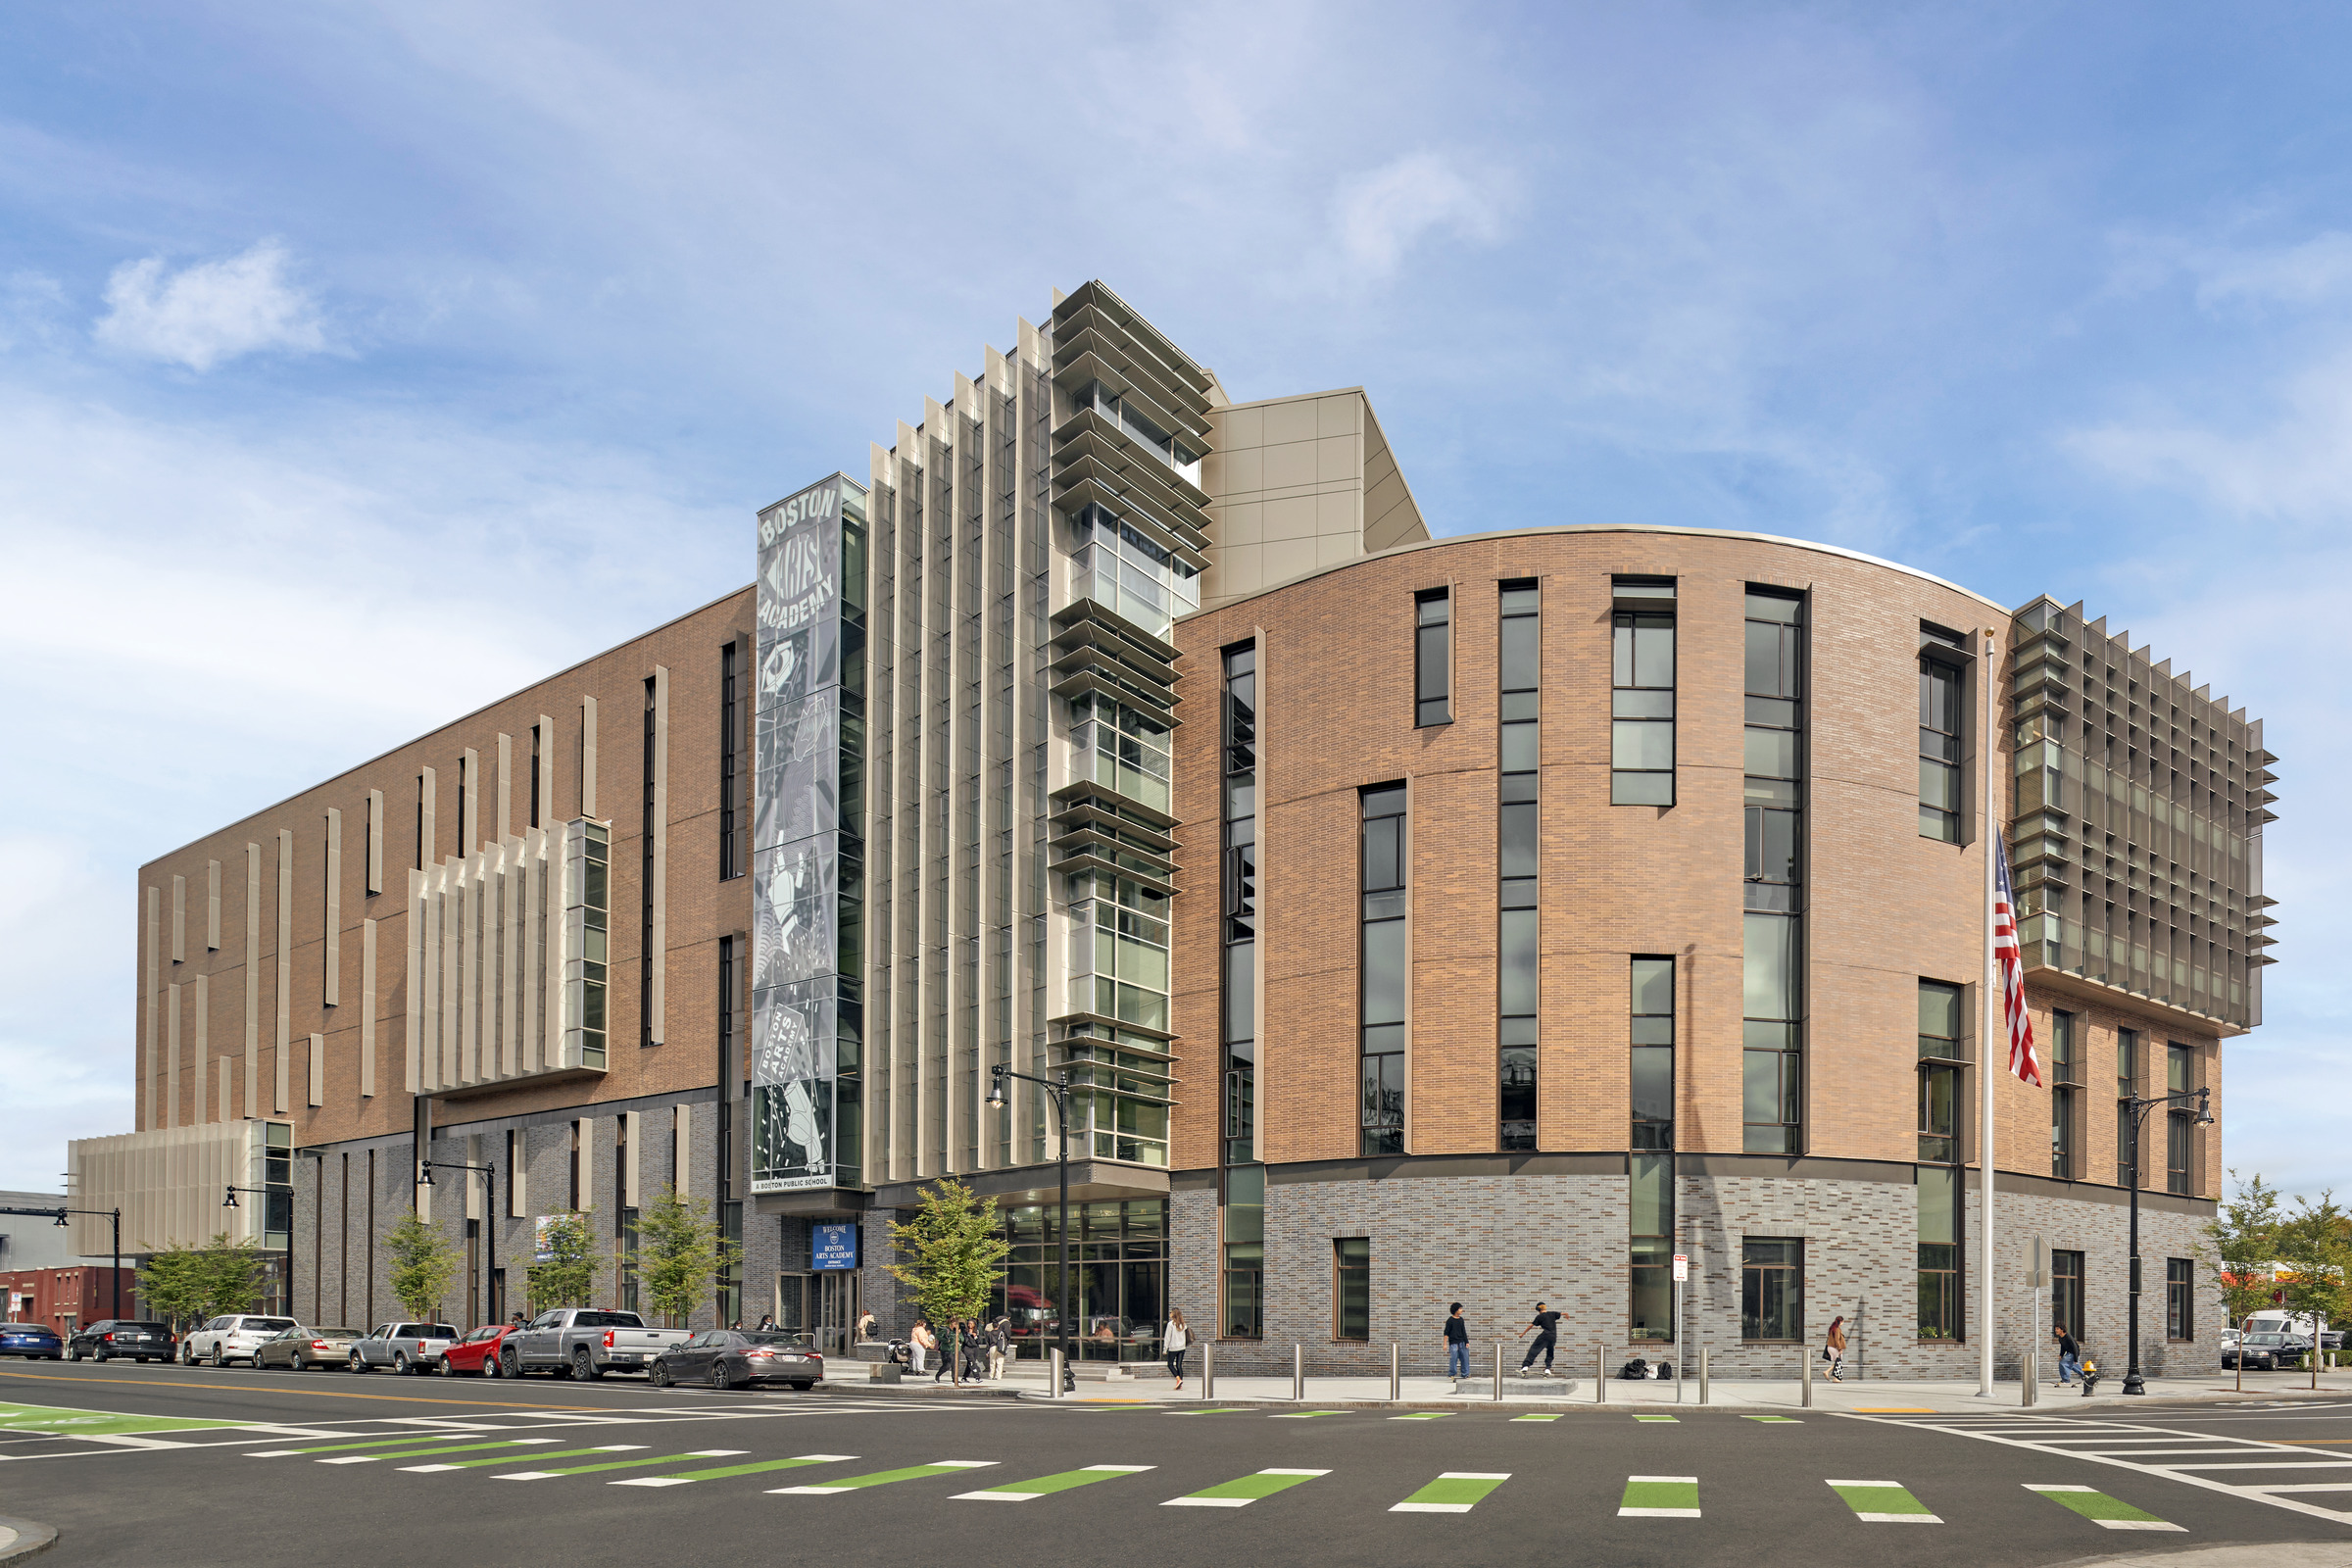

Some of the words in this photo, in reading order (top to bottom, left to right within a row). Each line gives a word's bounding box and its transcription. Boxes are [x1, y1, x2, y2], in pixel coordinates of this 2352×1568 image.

[760, 488, 837, 548] BOSTON
[758, 572, 834, 629] ACADEMY
[761, 1010, 783, 1069] BOSTON
[771, 1016, 792, 1075] ARTS
[778, 1021, 798, 1079] ACADEMY
[822, 1225, 847, 1234] WELCOME
